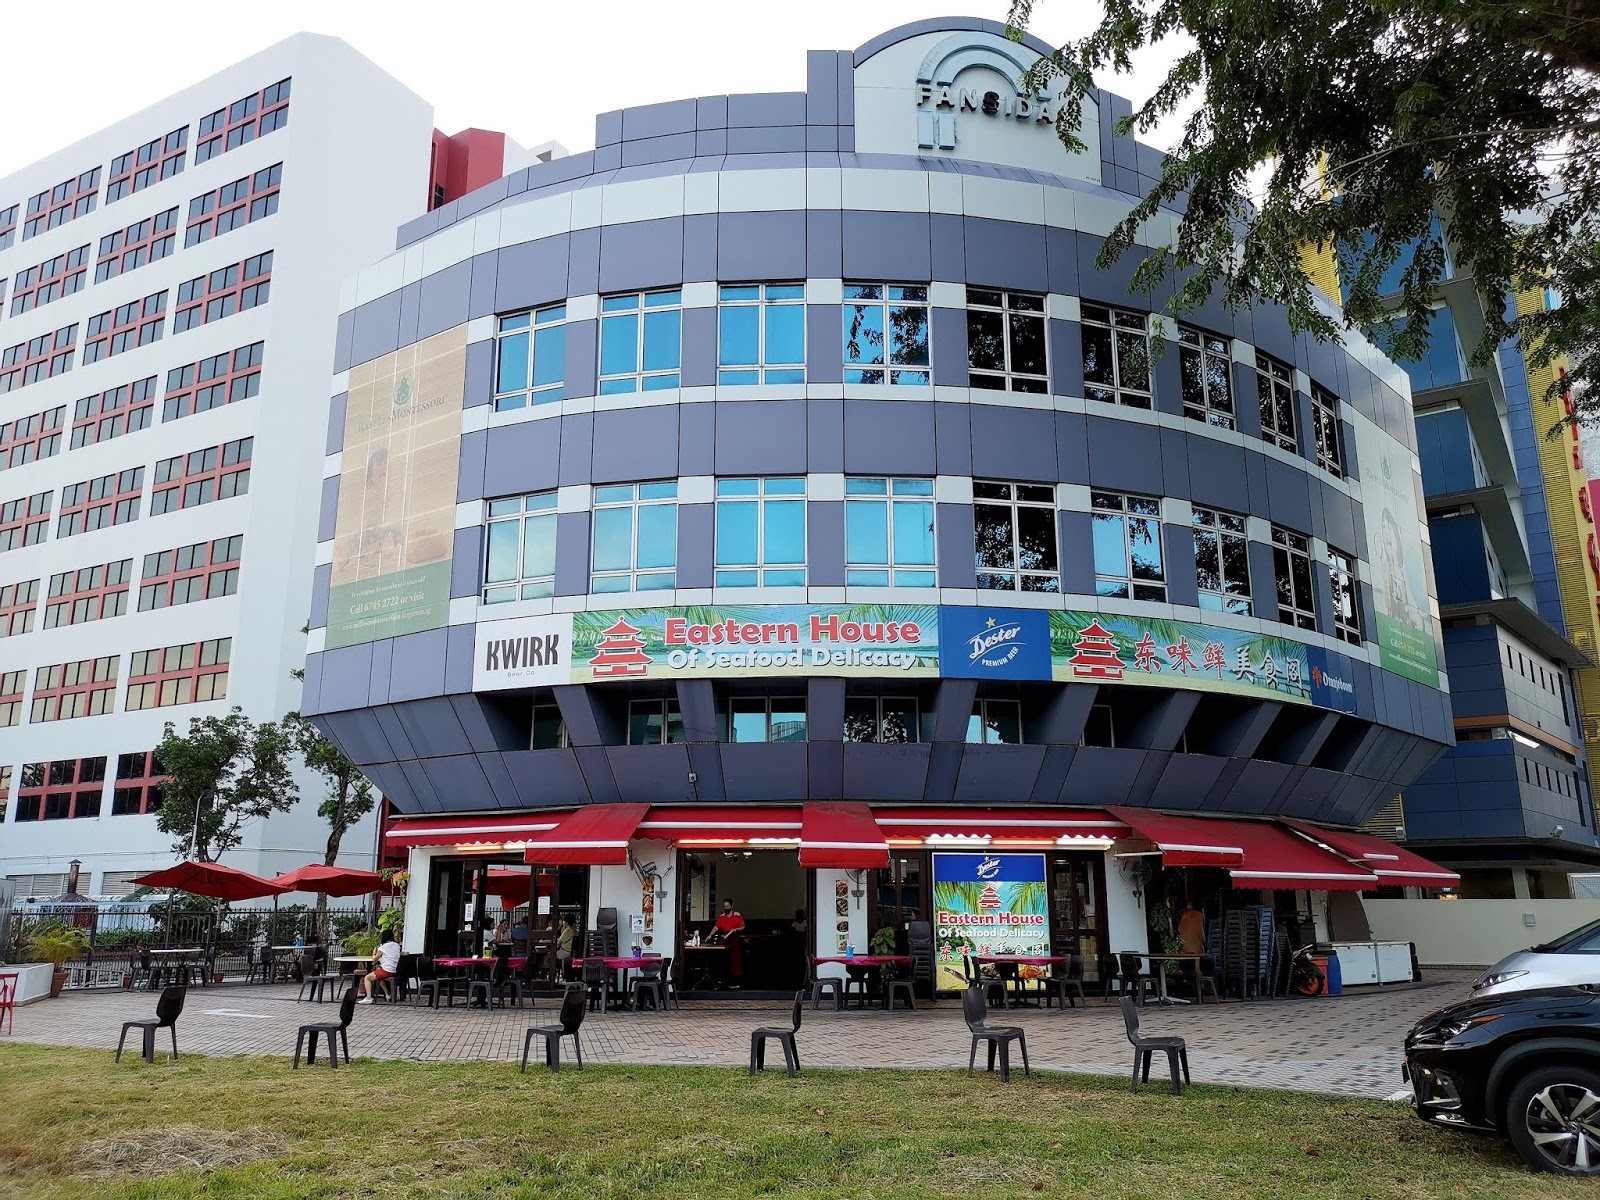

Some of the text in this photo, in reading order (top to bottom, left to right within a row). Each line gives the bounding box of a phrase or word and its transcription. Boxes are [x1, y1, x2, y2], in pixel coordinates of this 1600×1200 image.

[916, 83, 1054, 125] FANSIDA
[350, 602, 363, 615] Call
[381, 595, 399, 609] 2722
[410, 591, 425, 602] visit
[664, 614, 921, 646] Eastern House
[486, 634, 560, 672] KWIRK
[969, 626, 1021, 660] Dester
[667, 646, 917, 671] Of Seafood Delicacy
[981, 646, 1019, 667] PREMIUM BEER
[1134, 632, 1303, 690] 东味鲜美食阁
[977, 859, 1000, 876] Dester
[939, 912, 1044, 925] Eastern House
[938, 927, 1044, 939] Of Seafood Delicacy
